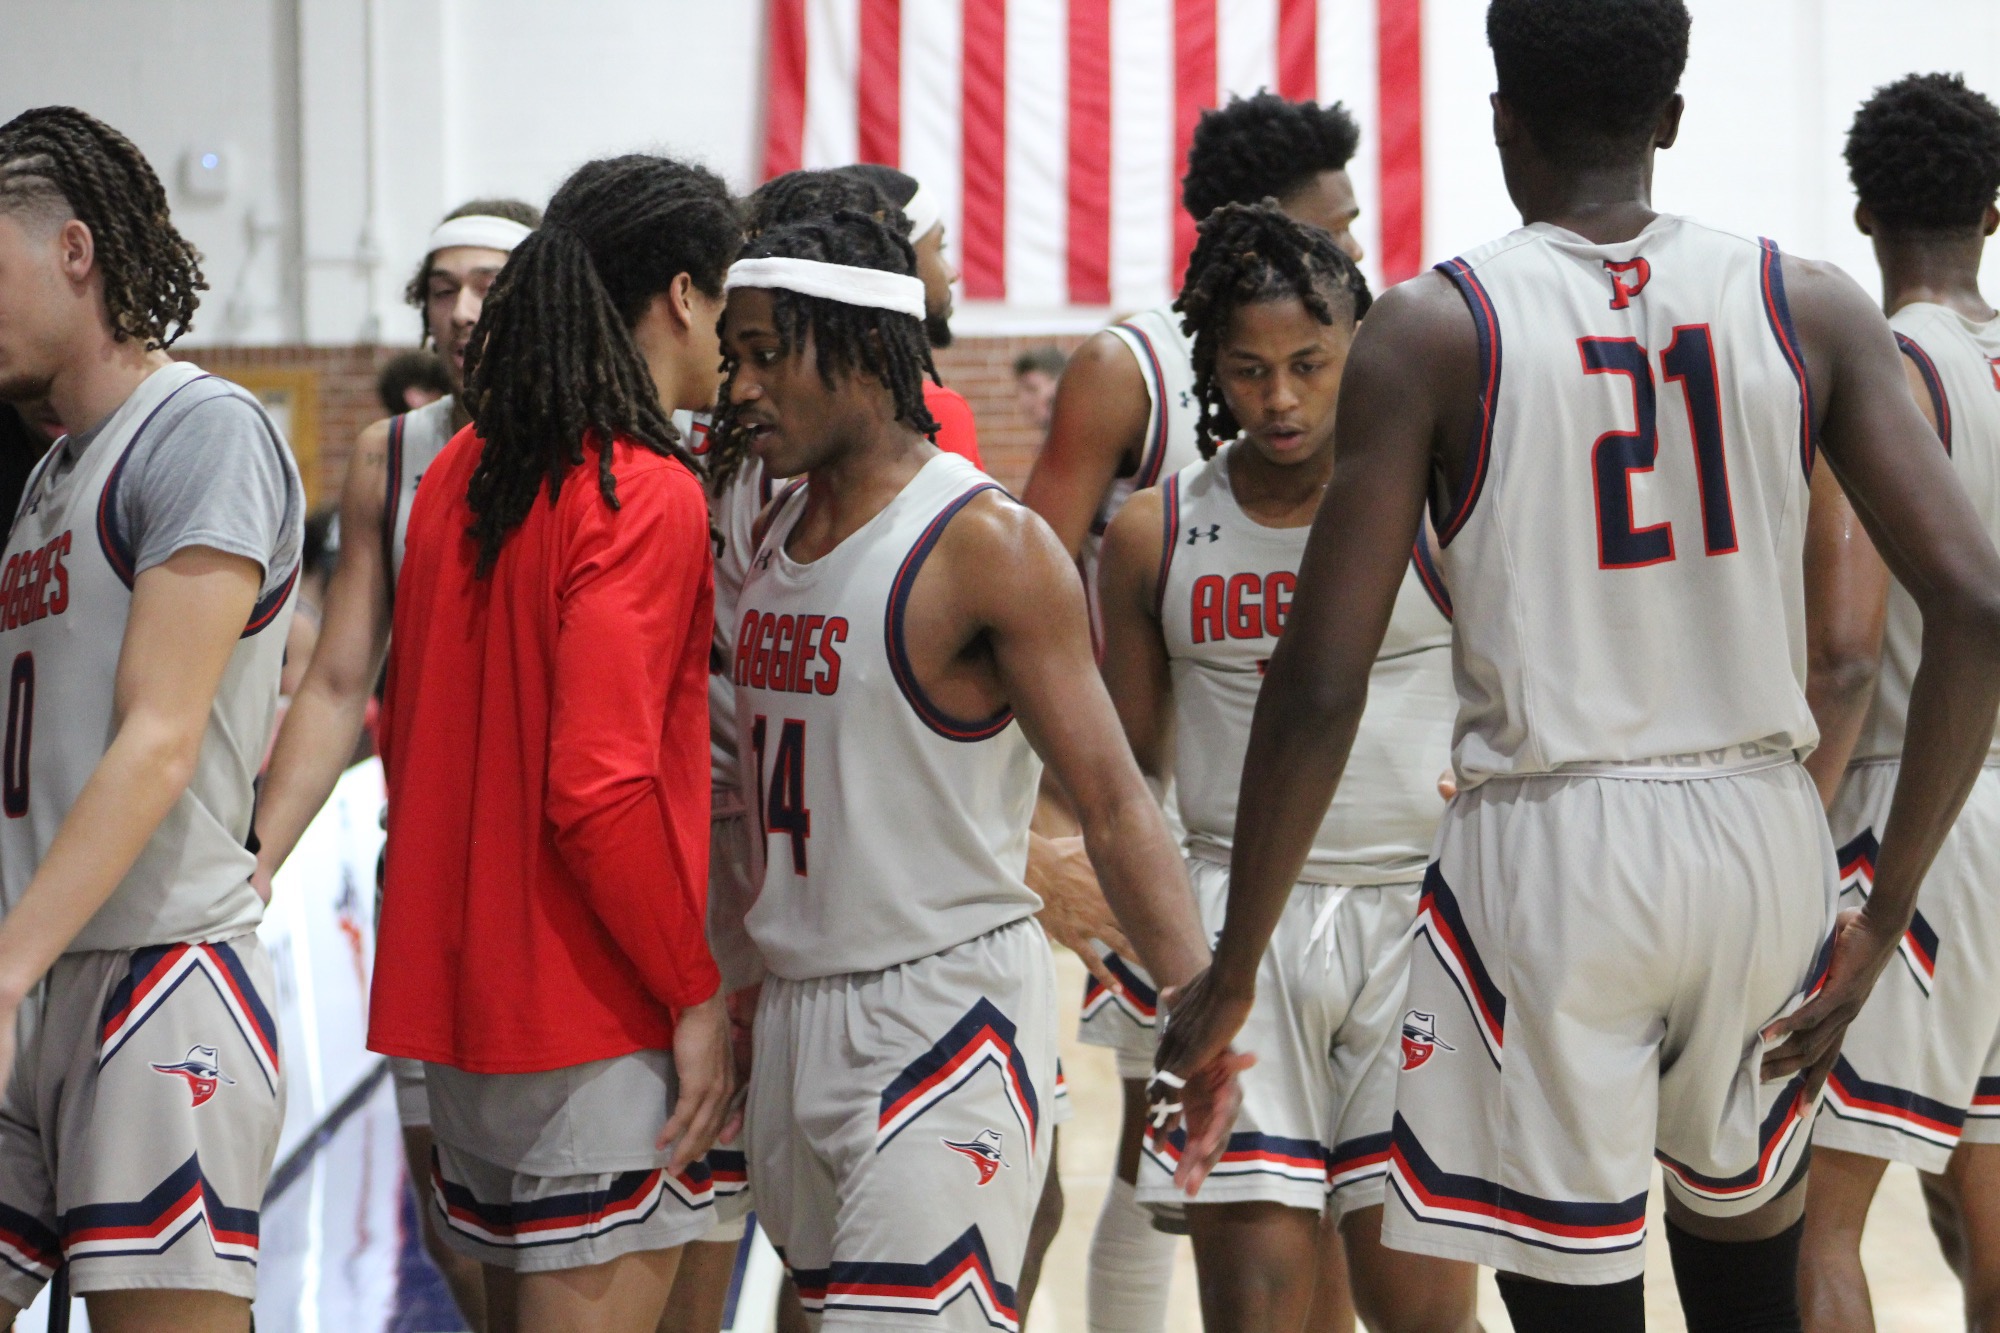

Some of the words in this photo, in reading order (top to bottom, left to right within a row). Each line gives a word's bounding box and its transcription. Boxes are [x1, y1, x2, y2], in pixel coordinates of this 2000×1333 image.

[1603, 257, 1651, 310] P
[1576, 323, 1739, 570] 21
[0, 529, 72, 633] AGGIES
[735, 609, 849, 696] AGGIES
[3, 650, 35, 819] 0
[752, 714, 811, 878] 14
[194, 1081, 215, 1098] P
